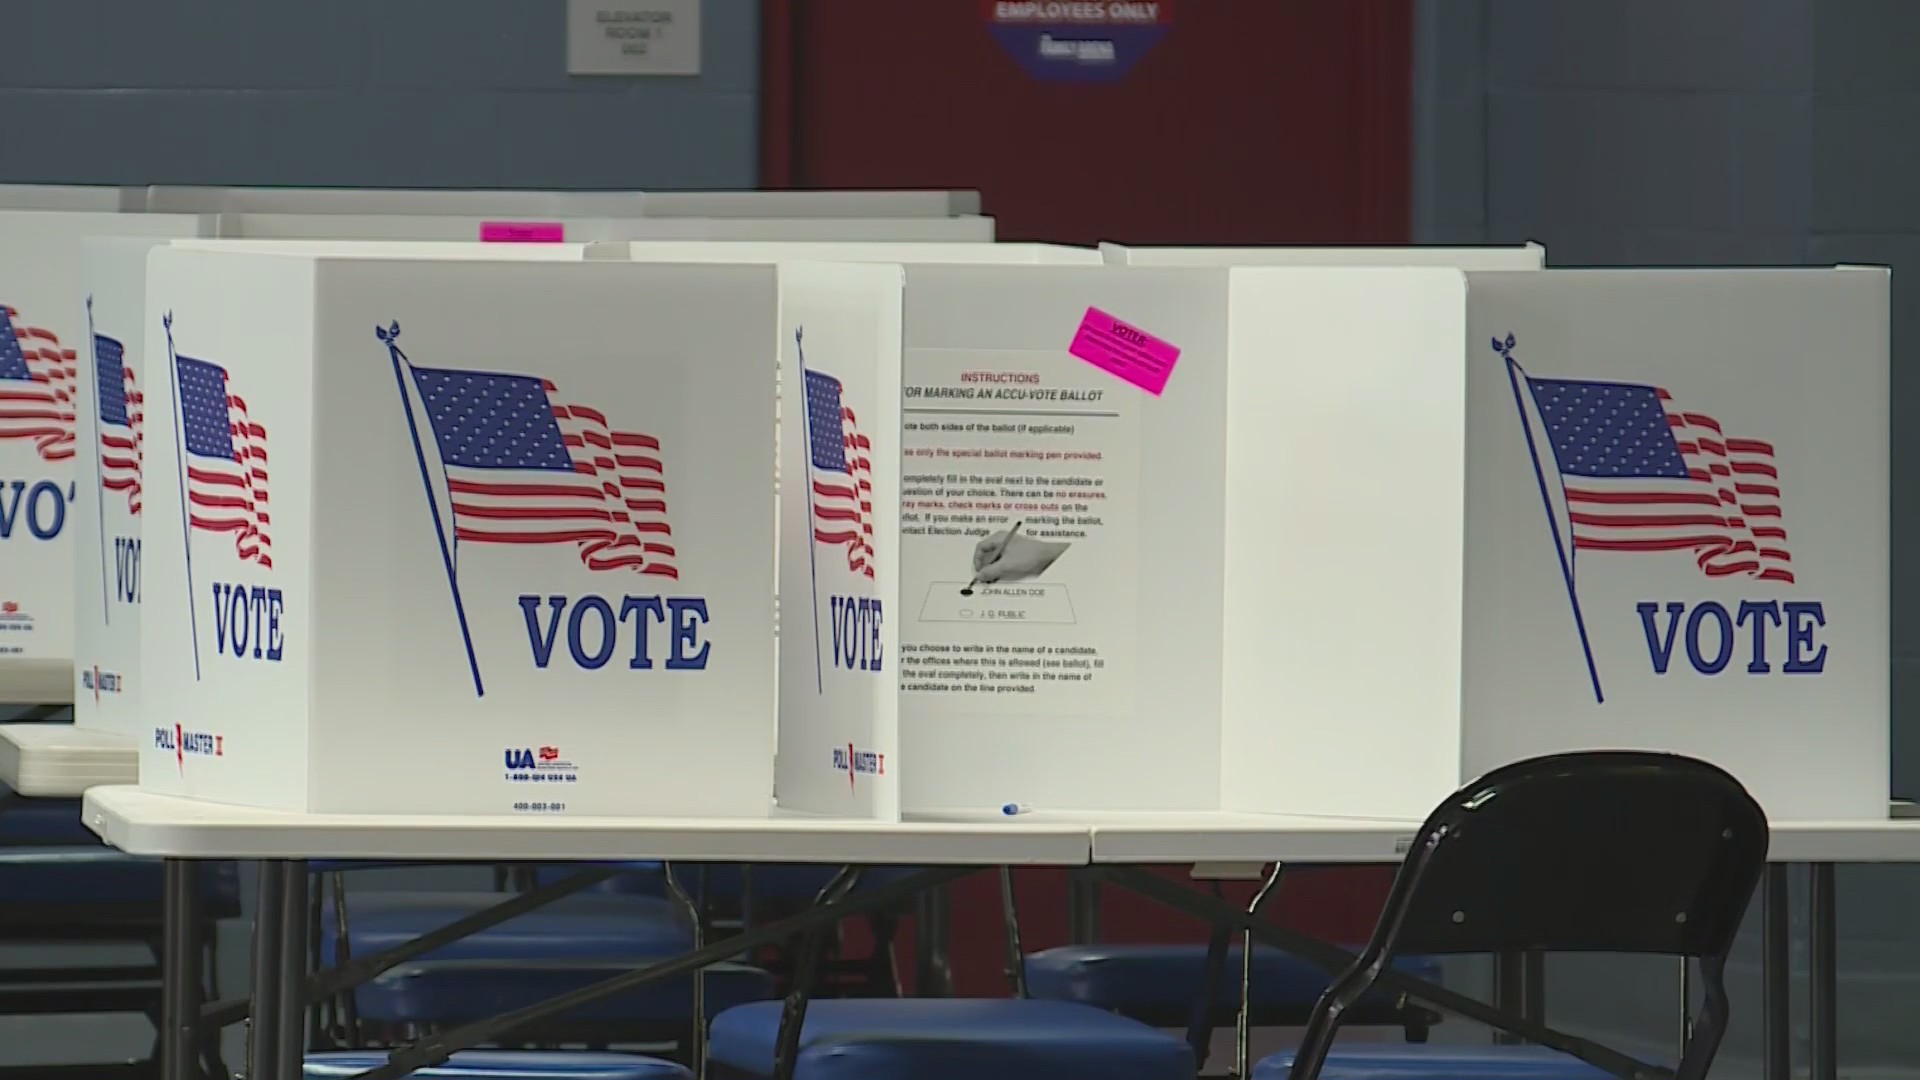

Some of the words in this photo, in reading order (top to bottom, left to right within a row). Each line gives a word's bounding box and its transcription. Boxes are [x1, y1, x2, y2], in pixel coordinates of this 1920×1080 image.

[995, 2, 1104, 19] EMPLOYEES
[1109, 2, 1158, 19] ONLY
[961, 373, 1040, 384] INSTRUCTIONS
[904, 386, 922, 399] OR
[923, 386, 975, 399] MARKING
[976, 388, 994, 399] AN
[994, 388, 1058, 400] ACCU-VOTE
[1060, 389, 1104, 401] BALLOT
[904, 423, 917, 431] ote
[920, 423, 939, 431] both
[941, 423, 964, 432] sides
[966, 423, 975, 432] of
[976, 423, 990, 432] the
[992, 424, 1016, 433] ballot
[1028, 424, 1075, 435] applicable)
[904, 449, 914, 457] se
[916, 448, 934, 458] only
[936, 448, 950, 457] the
[952, 449, 982, 458] special
[984, 450, 1008, 458] ballot
[1009, 451, 1044, 460] marking
[903, 474, 944, 485] ompletely
[946, 474, 958, 483] fill
[959, 475, 968, 484] in
[969, 475, 983, 484] the
[985, 475, 1003, 484] oval
[1005, 476, 1023, 485] next
[1025, 477, 1034, 485] to
[1036, 477, 1050, 485] the
[1051, 477, 1093, 486] candidate
[902, 488, 933, 497] uestion
[935, 487, 944, 497] of
[946, 489, 965, 498] your
[1000, 488, 1024, 498] There
[1026, 490, 1042, 498] can
[1043, 490, 1054, 498] be
[0, 480, 76, 541] VO
[902, 501, 915, 509] ray
[948, 501, 975, 509] check
[976, 502, 1002, 510] marks
[1014, 503, 1038, 511] cross
[1040, 503, 1060, 511] outs
[1061, 504, 1073, 512] on
[1075, 503, 1088, 512] the
[902, 513, 919, 521] llot.
[925, 513, 931, 521] If
[932, 514, 949, 524] you
[950, 514, 974, 523] make
[975, 515, 987, 523] an
[988, 515, 1008, 523] error
[1025, 516, 1060, 526] marking
[1062, 516, 1076, 525] the
[902, 526, 926, 535] ntact
[928, 526, 962, 535] Election
[964, 528, 990, 537] Judge
[1026, 528, 1038, 537] for
[981, 588, 1002, 596] JOHN
[1003, 588, 1027, 596] ALLEN
[1028, 588, 1046, 597] DOE
[212, 582, 284, 661] VOTE
[518, 594, 711, 670] VOTE
[831, 595, 883, 671] VOTE
[1636, 600, 1828, 675] VOTE
[900, 644, 918, 653] you
[920, 644, 950, 653] choose
[952, 644, 962, 653] to
[963, 645, 985, 653] write
[986, 645, 995, 653] in
[996, 645, 1010, 654] the
[1011, 646, 1035, 654] name
[1037, 646, 1046, 654] of
[906, 657, 921, 665] the
[922, 656, 951, 666] offices
[953, 657, 979, 666] where
[980, 658, 997, 666] this
[998, 658, 1007, 667] is
[1008, 658, 1041, 668] allowed
[902, 669, 916, 678] the
[918, 669, 936, 678] oval
[988, 670, 1008, 679] then
[1009, 671, 1030, 680] write
[1032, 671, 1041, 680] in
[1042, 671, 1056, 680] the
[1058, 672, 1081, 680] name
[1083, 672, 1092, 681] of
[908, 682, 949, 691] candidate
[950, 683, 962, 691] on
[963, 683, 978, 691] the
[979, 684, 995, 692] line
[155, 727, 175, 749] POLL
[183, 731, 213, 755] MASTER
[504, 747, 537, 769] UA
[833, 749, 848, 769] POLL
[854, 752, 877, 773] MASTER
